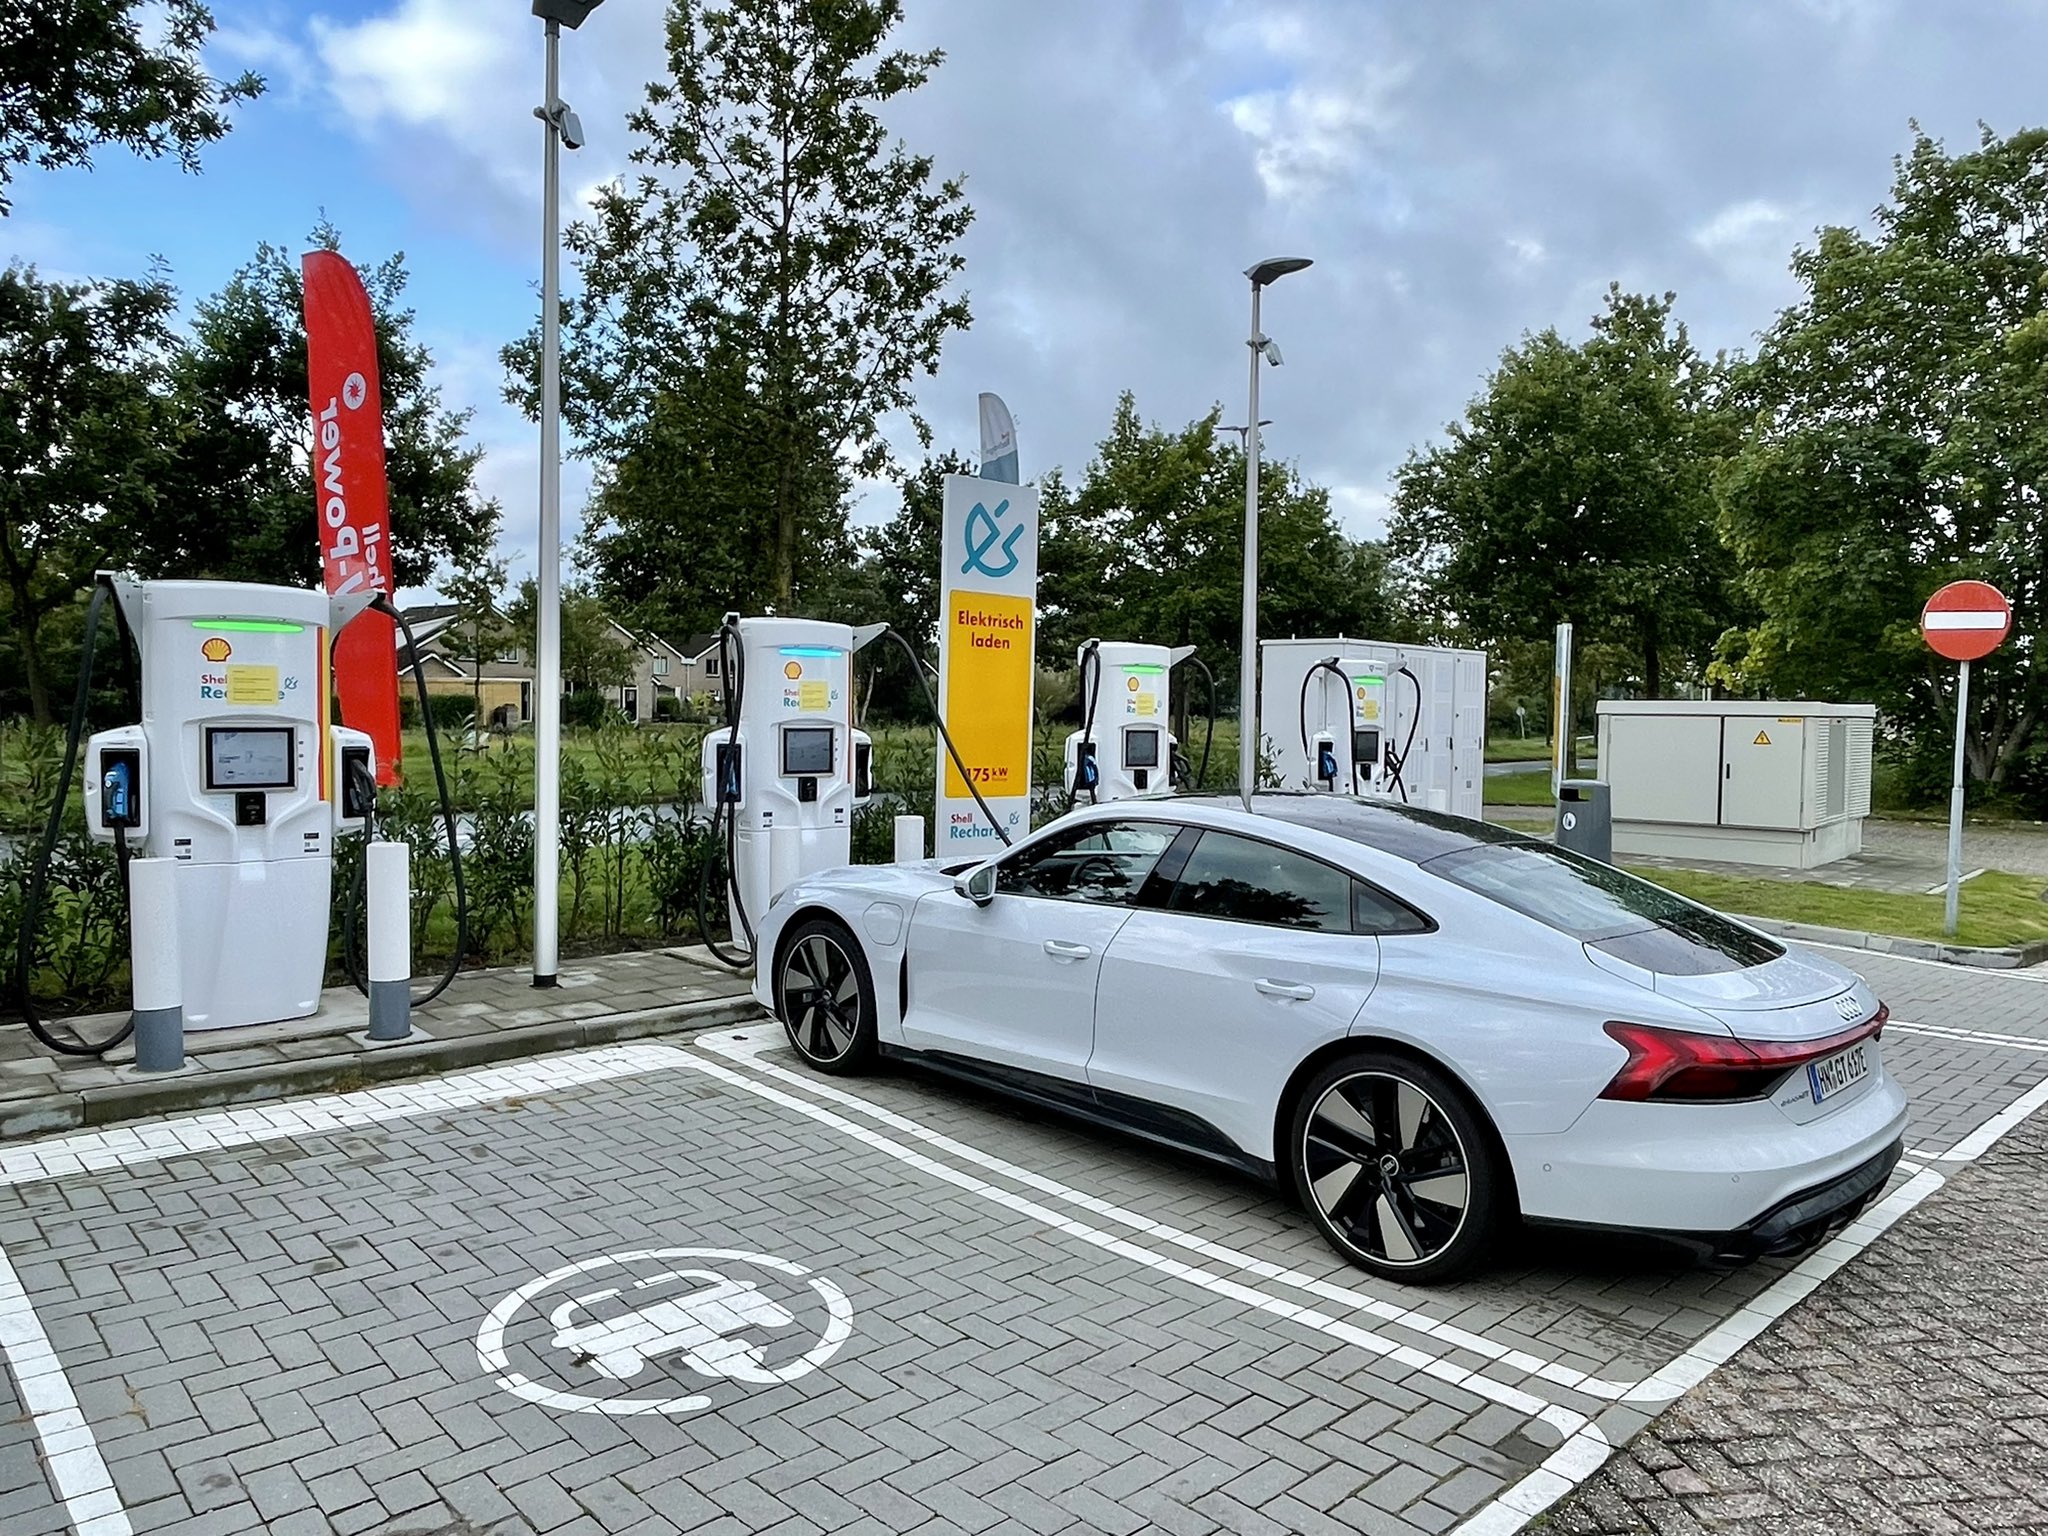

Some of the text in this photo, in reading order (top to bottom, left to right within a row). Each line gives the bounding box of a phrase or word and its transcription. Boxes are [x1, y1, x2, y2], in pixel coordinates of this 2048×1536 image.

[958, 609, 1023, 630] Elektrisch
[971, 631, 1010, 649] laden
[201, 673, 228, 685] Shel
[951, 812, 973, 824] Shell
